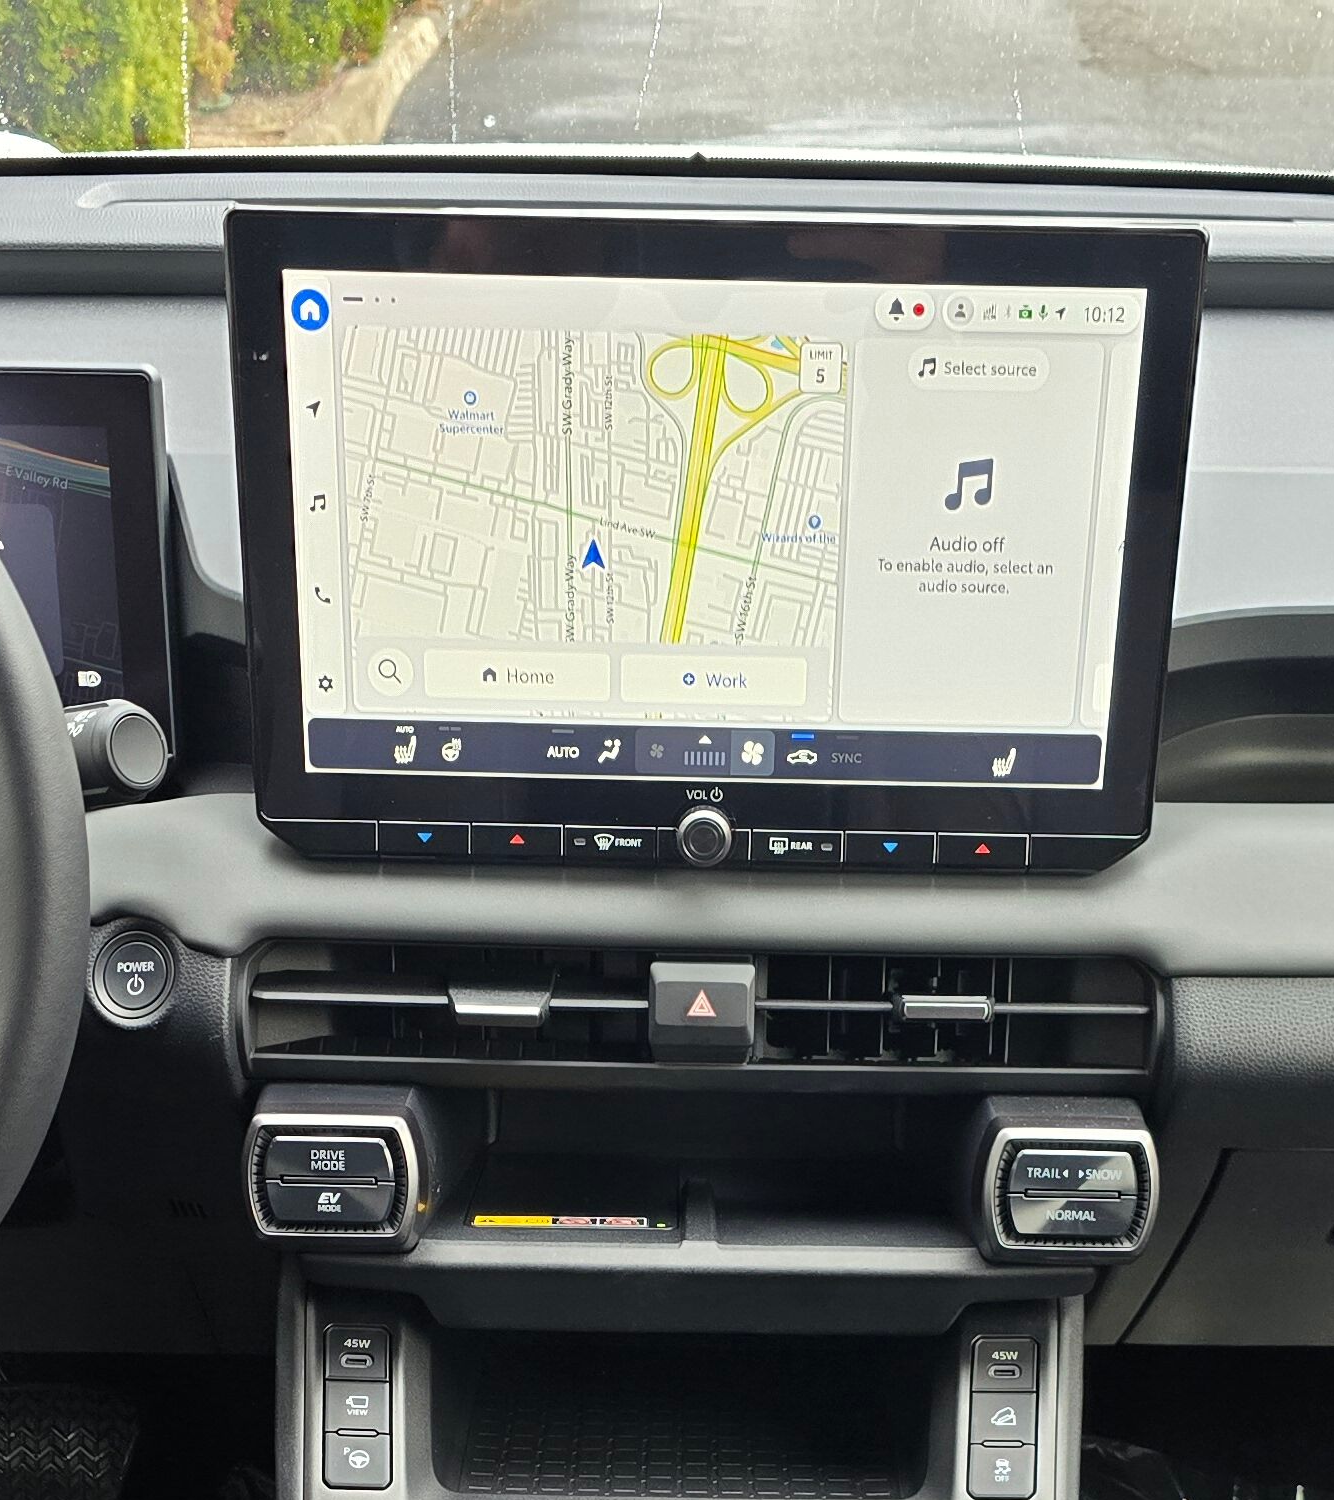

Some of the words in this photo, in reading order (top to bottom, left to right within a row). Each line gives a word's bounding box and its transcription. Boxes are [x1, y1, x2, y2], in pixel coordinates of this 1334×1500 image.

[1083, 306, 1126, 324] 10:12
[562, 337, 574, 366] Way
[809, 350, 833, 362] LIMIT
[944, 361, 986, 377] Select
[991, 364, 1037, 377] source
[815, 369, 825, 384] 5
[562, 370, 574, 410] Grady
[447, 409, 495, 423] Walmart
[438, 423, 505, 437] Supercenter
[562, 412, 572, 435] SW
[15, 467, 51, 488] Valley
[52, 477, 68, 490] Rd
[762, 533, 803, 544] Wizards
[930, 536, 978, 552] Audio
[982, 537, 1006, 553] off
[565, 554, 577, 581] Way
[878, 559, 893, 572] To
[896, 560, 944, 573] enable
[946, 561, 989, 577] audio,
[993, 562, 1033, 575] select
[1037, 565, 1054, 575] an
[918, 580, 957, 593] audio
[961, 583, 1010, 595] source.
[565, 590, 577, 622] Grady
[506, 668, 554, 685] Home
[706, 672, 748, 689] Work
[395, 725, 415, 733] AUTO
[547, 744, 579, 759] AUTO
[831, 751, 862, 765] SYNC
[686, 788, 708, 800] VOL
[614, 837, 642, 848] FRONT
[790, 841, 813, 851] REAR
[117, 961, 155, 973] POWER
[310, 1149, 346, 1161] DRIVE
[310, 1160, 346, 1171] MODE
[1027, 1167, 1061, 1179] TRAIL
[1085, 1169, 1122, 1181] SNOW
[317, 1192, 342, 1204] EV
[317, 1204, 342, 1213] MODE
[1046, 1210, 1096, 1222] NORMAL
[343, 1338, 371, 1349] 45W
[991, 1351, 1018, 1361] 45W
[346, 1408, 368, 1416] VIEW
